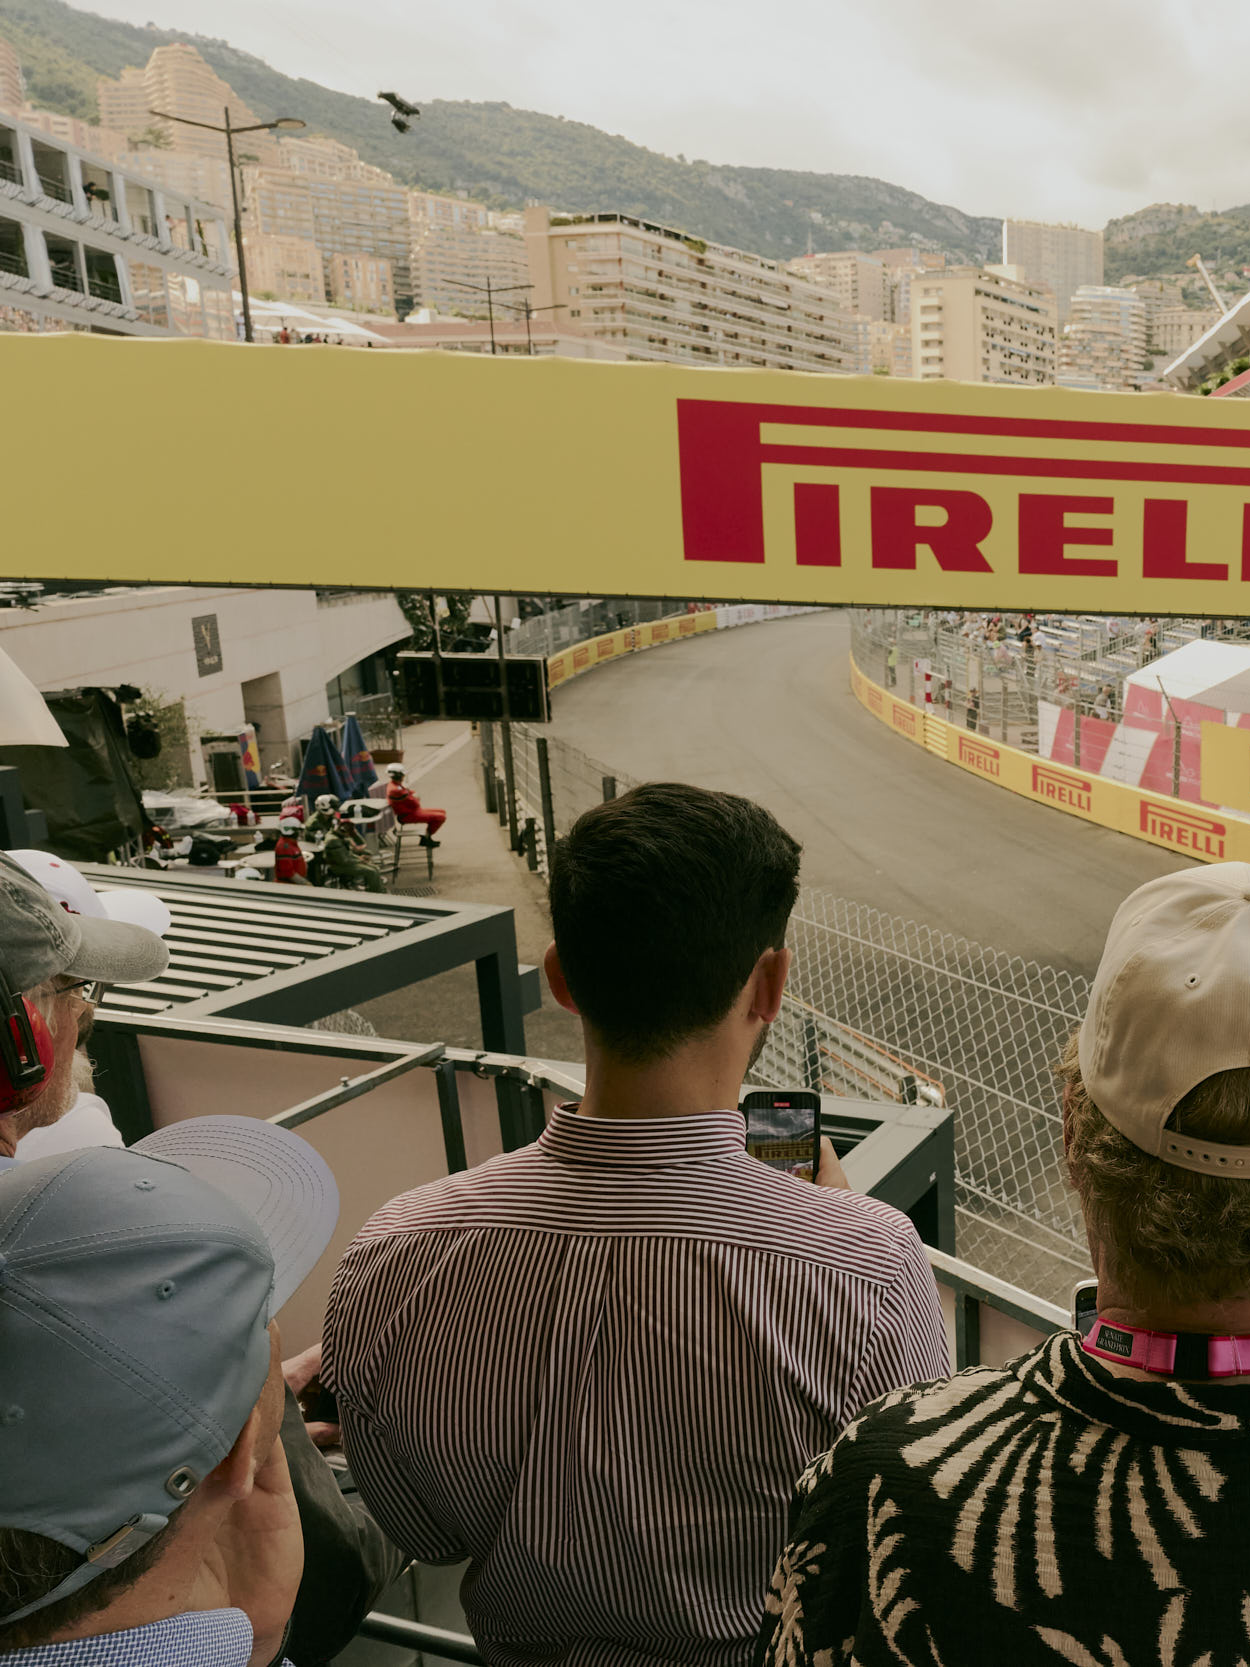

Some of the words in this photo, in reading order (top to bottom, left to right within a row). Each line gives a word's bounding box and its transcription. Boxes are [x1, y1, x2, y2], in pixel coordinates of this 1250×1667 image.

[959, 735, 1000, 777] PIRELLI
[1032, 764, 1092, 812] PIRELLI
[1139, 799, 1226, 858] PIRELLI
